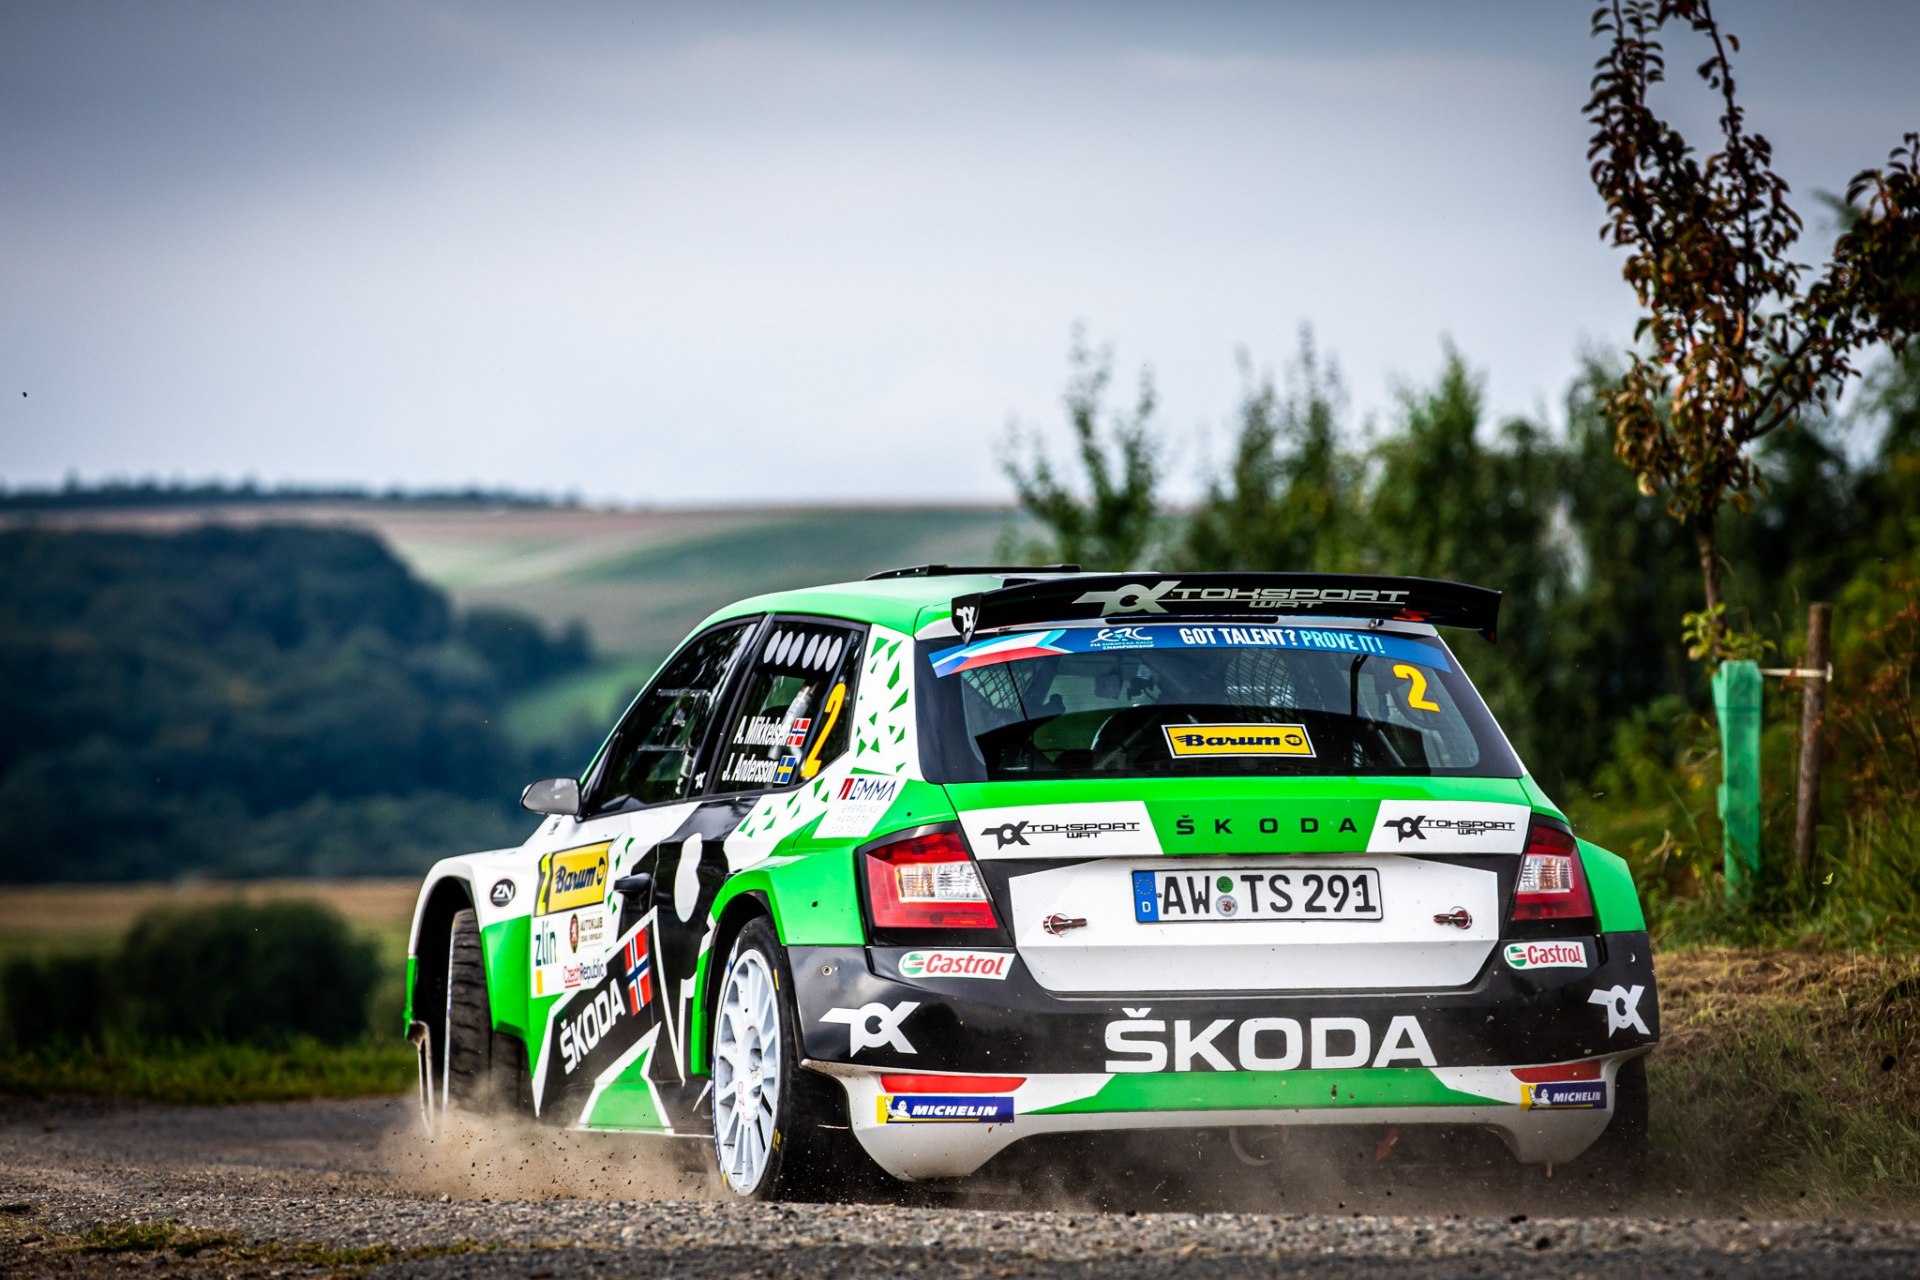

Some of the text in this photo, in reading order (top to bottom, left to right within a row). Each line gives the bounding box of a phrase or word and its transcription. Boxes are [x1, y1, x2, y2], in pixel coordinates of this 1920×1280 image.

[1171, 588, 1409, 602] TOKSPORT
[1178, 628, 1386, 654] GOT TALENT? PROVE IT!
[1392, 664, 1440, 712] 2
[800, 682, 846, 778] 2
[1174, 733, 1280, 747] Barum
[1027, 822, 1140, 832] TOKSPORT
[1424, 819, 1515, 830] TOKSPORT
[556, 867, 596, 894] Barum
[493, 884, 513, 899] ZN
[1142, 874, 1376, 914] D AW TS 291
[926, 954, 1007, 975] Castrol
[1528, 945, 1584, 964] Castrol
[560, 978, 626, 1075] ŠKODA
[1105, 1007, 1438, 1073] ŠKODA
[1553, 1091, 1601, 1103] MICHELIN
[912, 1105, 998, 1117] MICHELIN
